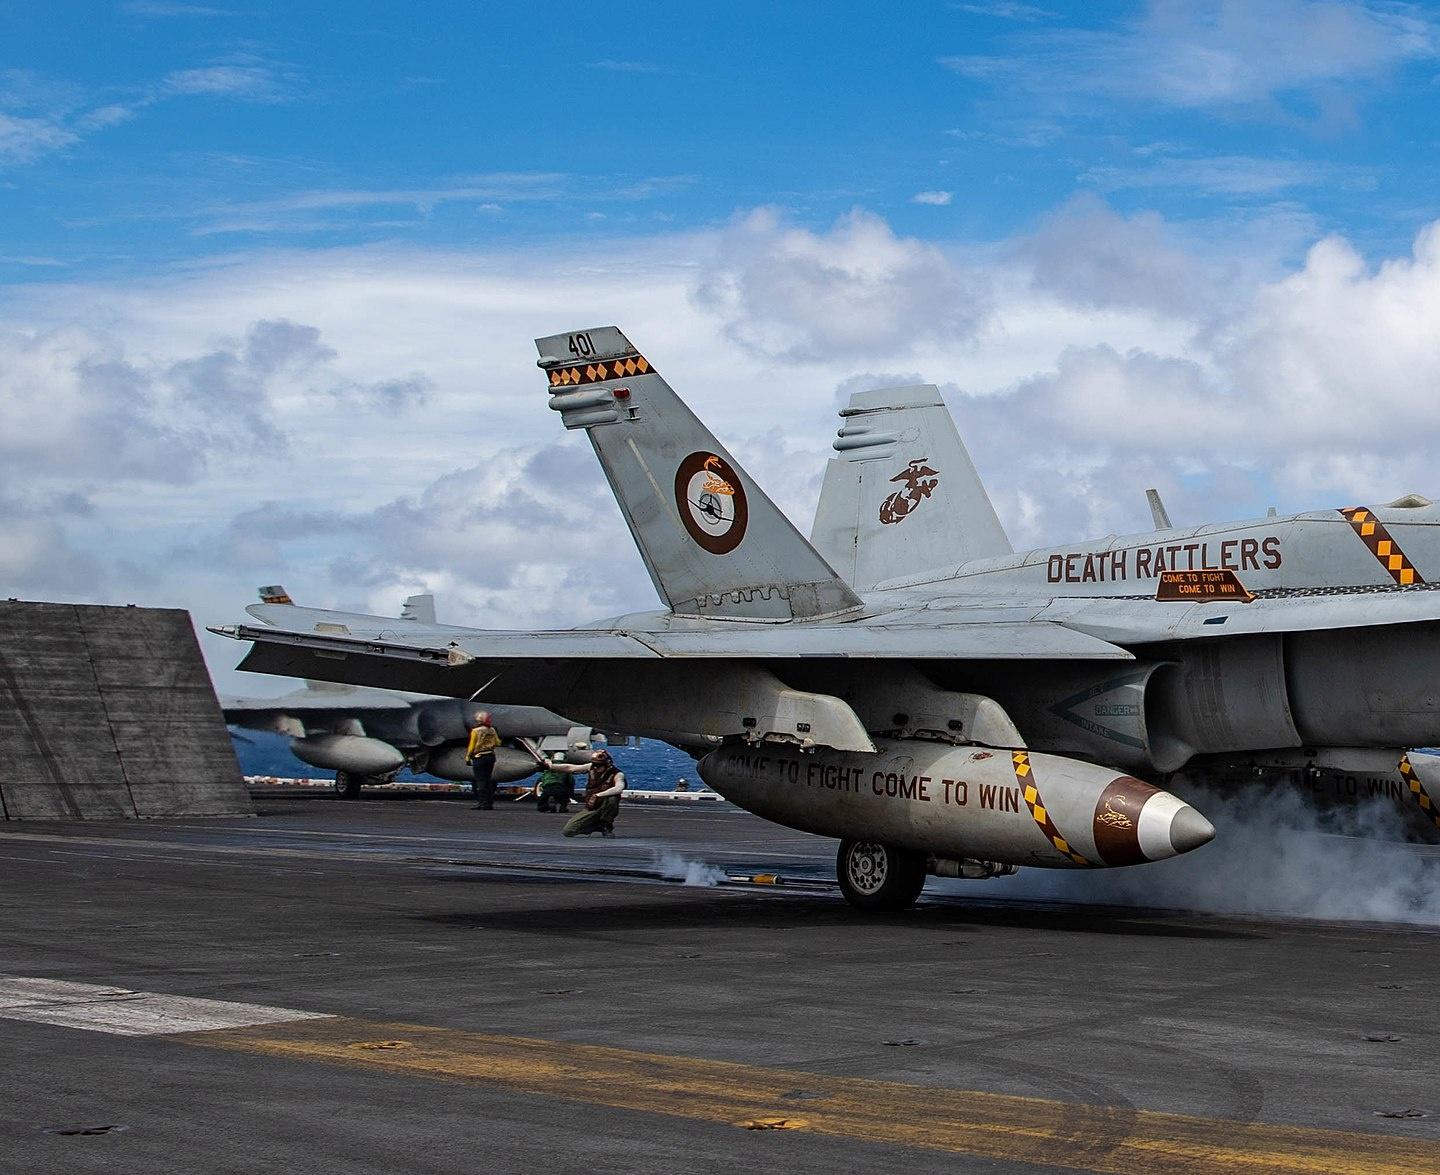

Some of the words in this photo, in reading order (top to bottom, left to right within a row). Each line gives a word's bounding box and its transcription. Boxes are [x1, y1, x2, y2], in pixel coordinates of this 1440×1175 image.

[568, 332, 597, 357] 401
[1047, 550, 1127, 583] DEATH
[1136, 537, 1283, 579] RATTLERS
[1162, 574, 1186, 583] COME
[1188, 573, 1198, 582] TO
[1202, 573, 1225, 582] FIGHT
[1178, 584, 1202, 593] COME
[1204, 584, 1215, 593] TO
[1220, 584, 1236, 593] WIN
[777, 759, 799, 784] TO
[806, 762, 864, 793] FIGHT
[871, 771, 932, 801] COME
[942, 779, 968, 806] TO
[979, 783, 1020, 813] WIN
[1335, 774, 1358, 797] TO
[1367, 777, 1405, 802] WIN
